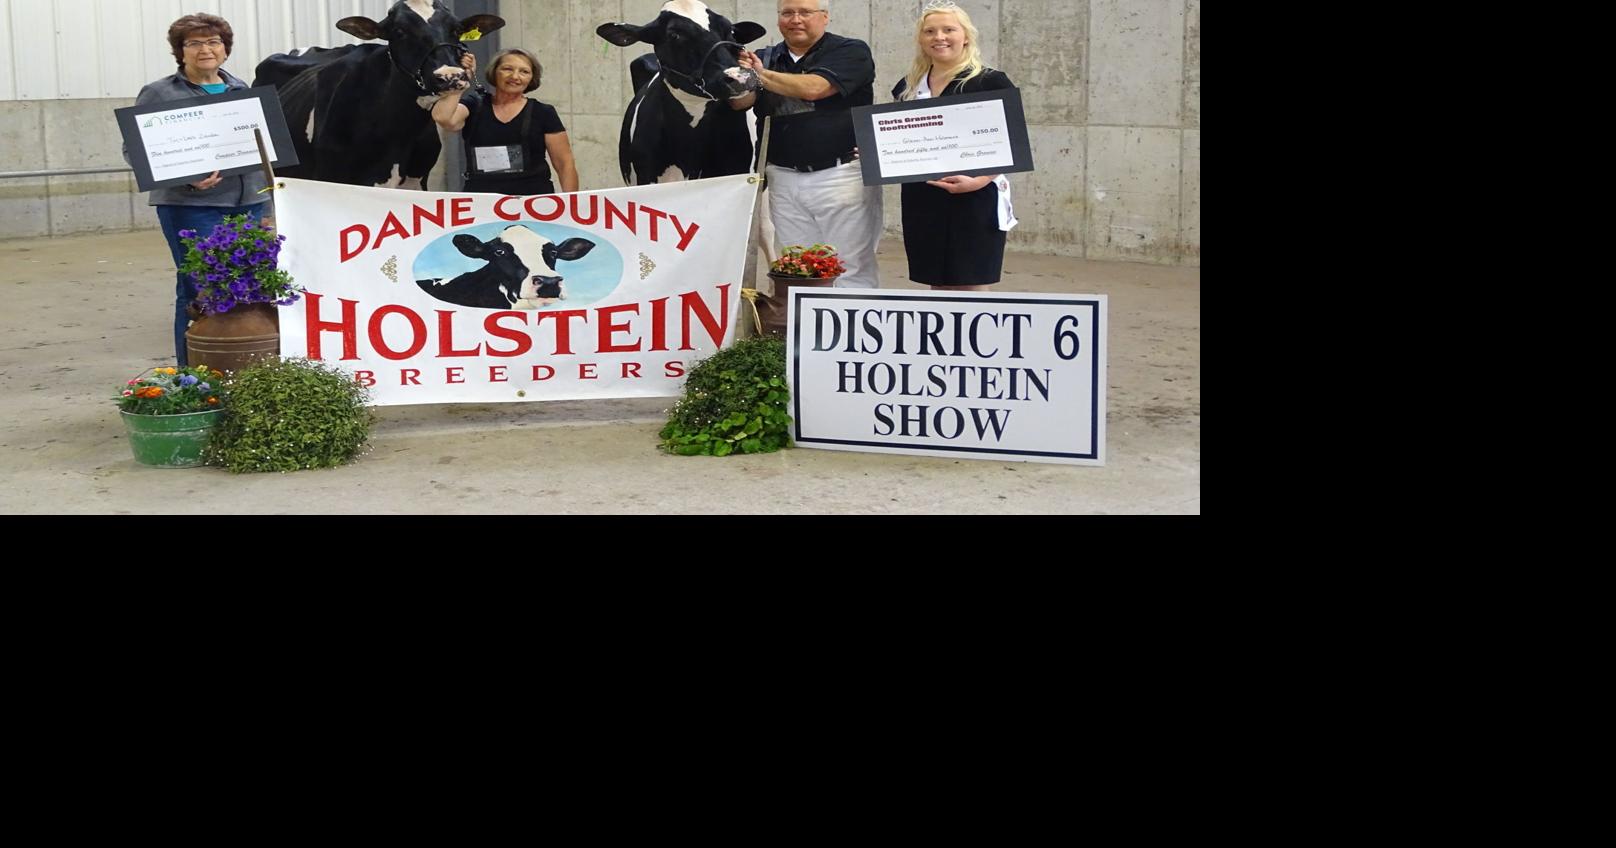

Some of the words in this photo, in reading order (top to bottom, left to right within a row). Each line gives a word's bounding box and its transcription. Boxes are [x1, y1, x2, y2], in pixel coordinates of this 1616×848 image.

[163, 110, 204, 121] COMPEER
[233, 123, 259, 131] $500.00
[878, 118, 903, 126] Chris
[972, 127, 999, 135] $250.00
[340, 196, 476, 263] DANE
[493, 193, 701, 252] COUNTY
[300, 283, 732, 362] HOLSTEIN
[811, 307, 1032, 360] DISTRICT
[1053, 314, 1080, 361] 6
[353, 360, 686, 389] BREEDERS
[836, 360, 1053, 403] HOLSTEIN
[873, 402, 1013, 443] SHOW
